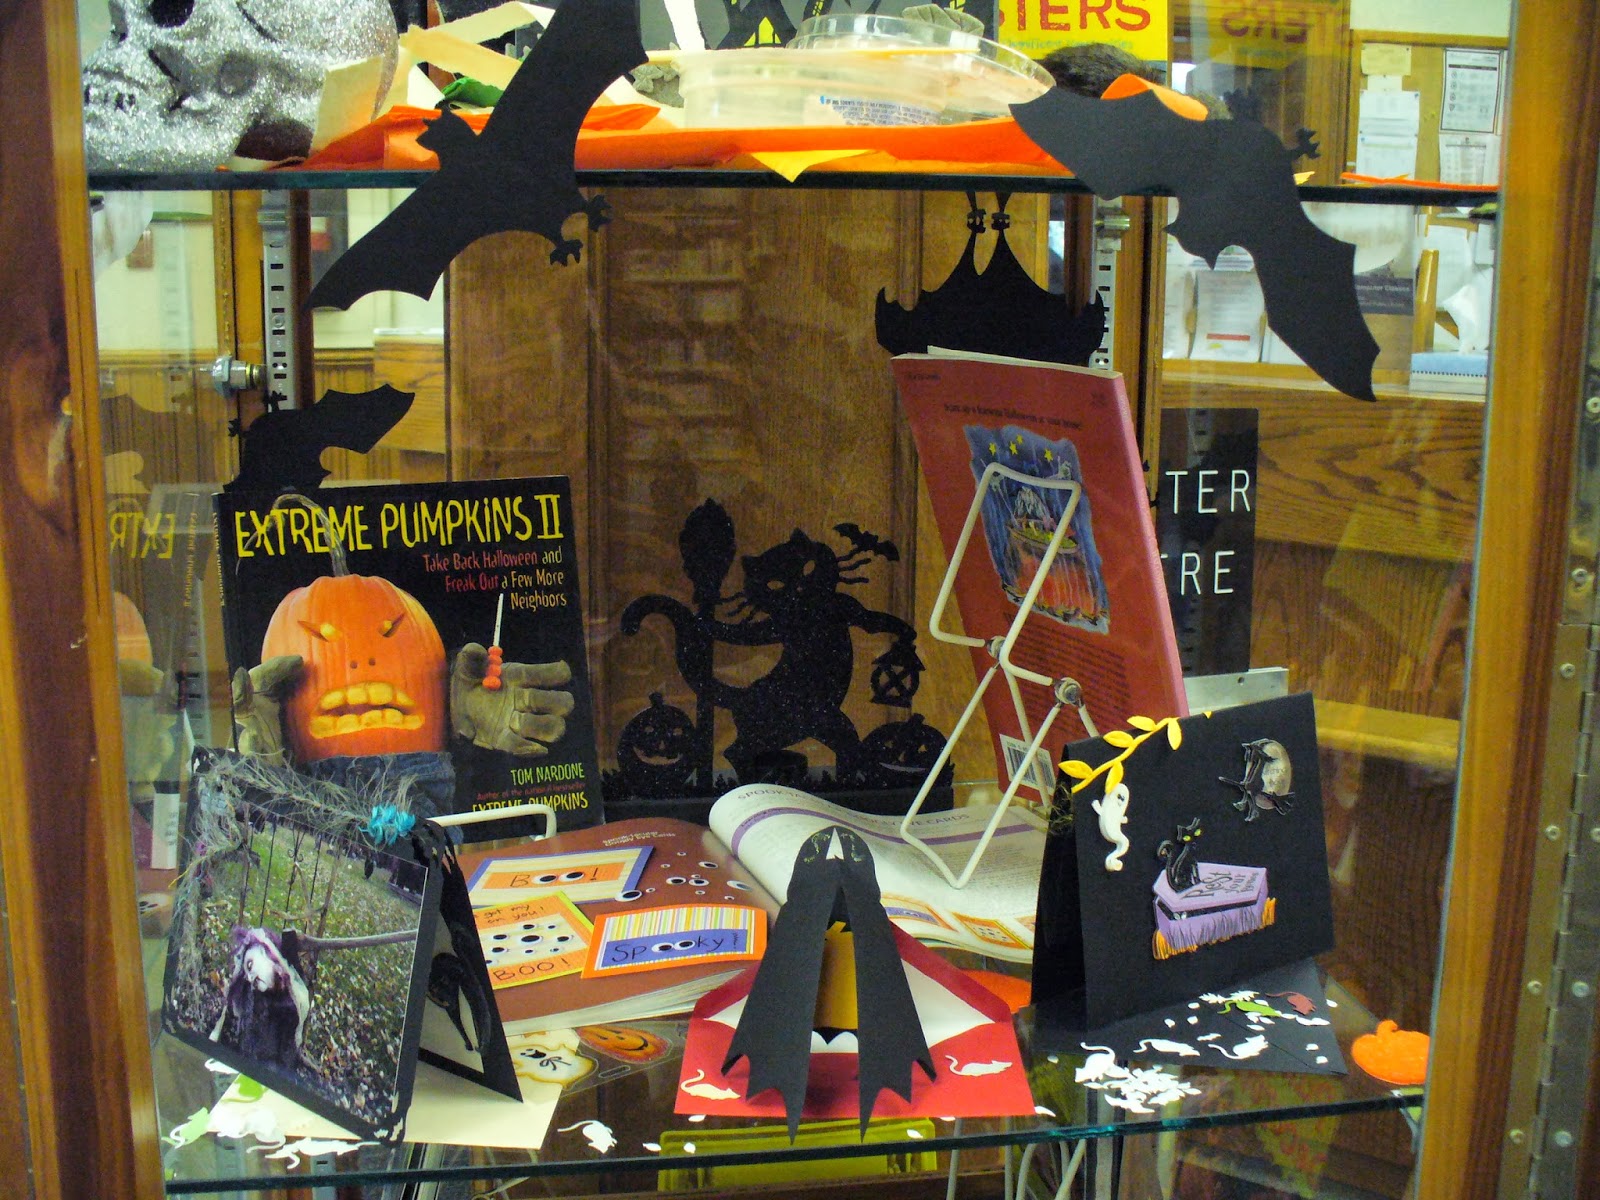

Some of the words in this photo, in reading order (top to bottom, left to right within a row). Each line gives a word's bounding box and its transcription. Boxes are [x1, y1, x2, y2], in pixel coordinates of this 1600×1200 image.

[1165, 469, 1251, 514] TER
[234, 505, 373, 558] EXTREME
[381, 496, 533, 548] PUMPKINS
[534, 494, 564, 540] II
[422, 552, 450, 572] Take
[453, 551, 480, 571] Back
[483, 549, 538, 569] Halloween
[542, 546, 562, 565] and
[445, 573, 476, 592] Freak
[480, 571, 499, 591] Out
[501, 575, 508, 589] a
[511, 570, 533, 588] Few
[536, 568, 564, 586] More
[1160, 551, 1235, 595] RE
[510, 590, 567, 613] Neighbors
[510, 767, 534, 785] TOM
[535, 762, 585, 783] NARDONE
